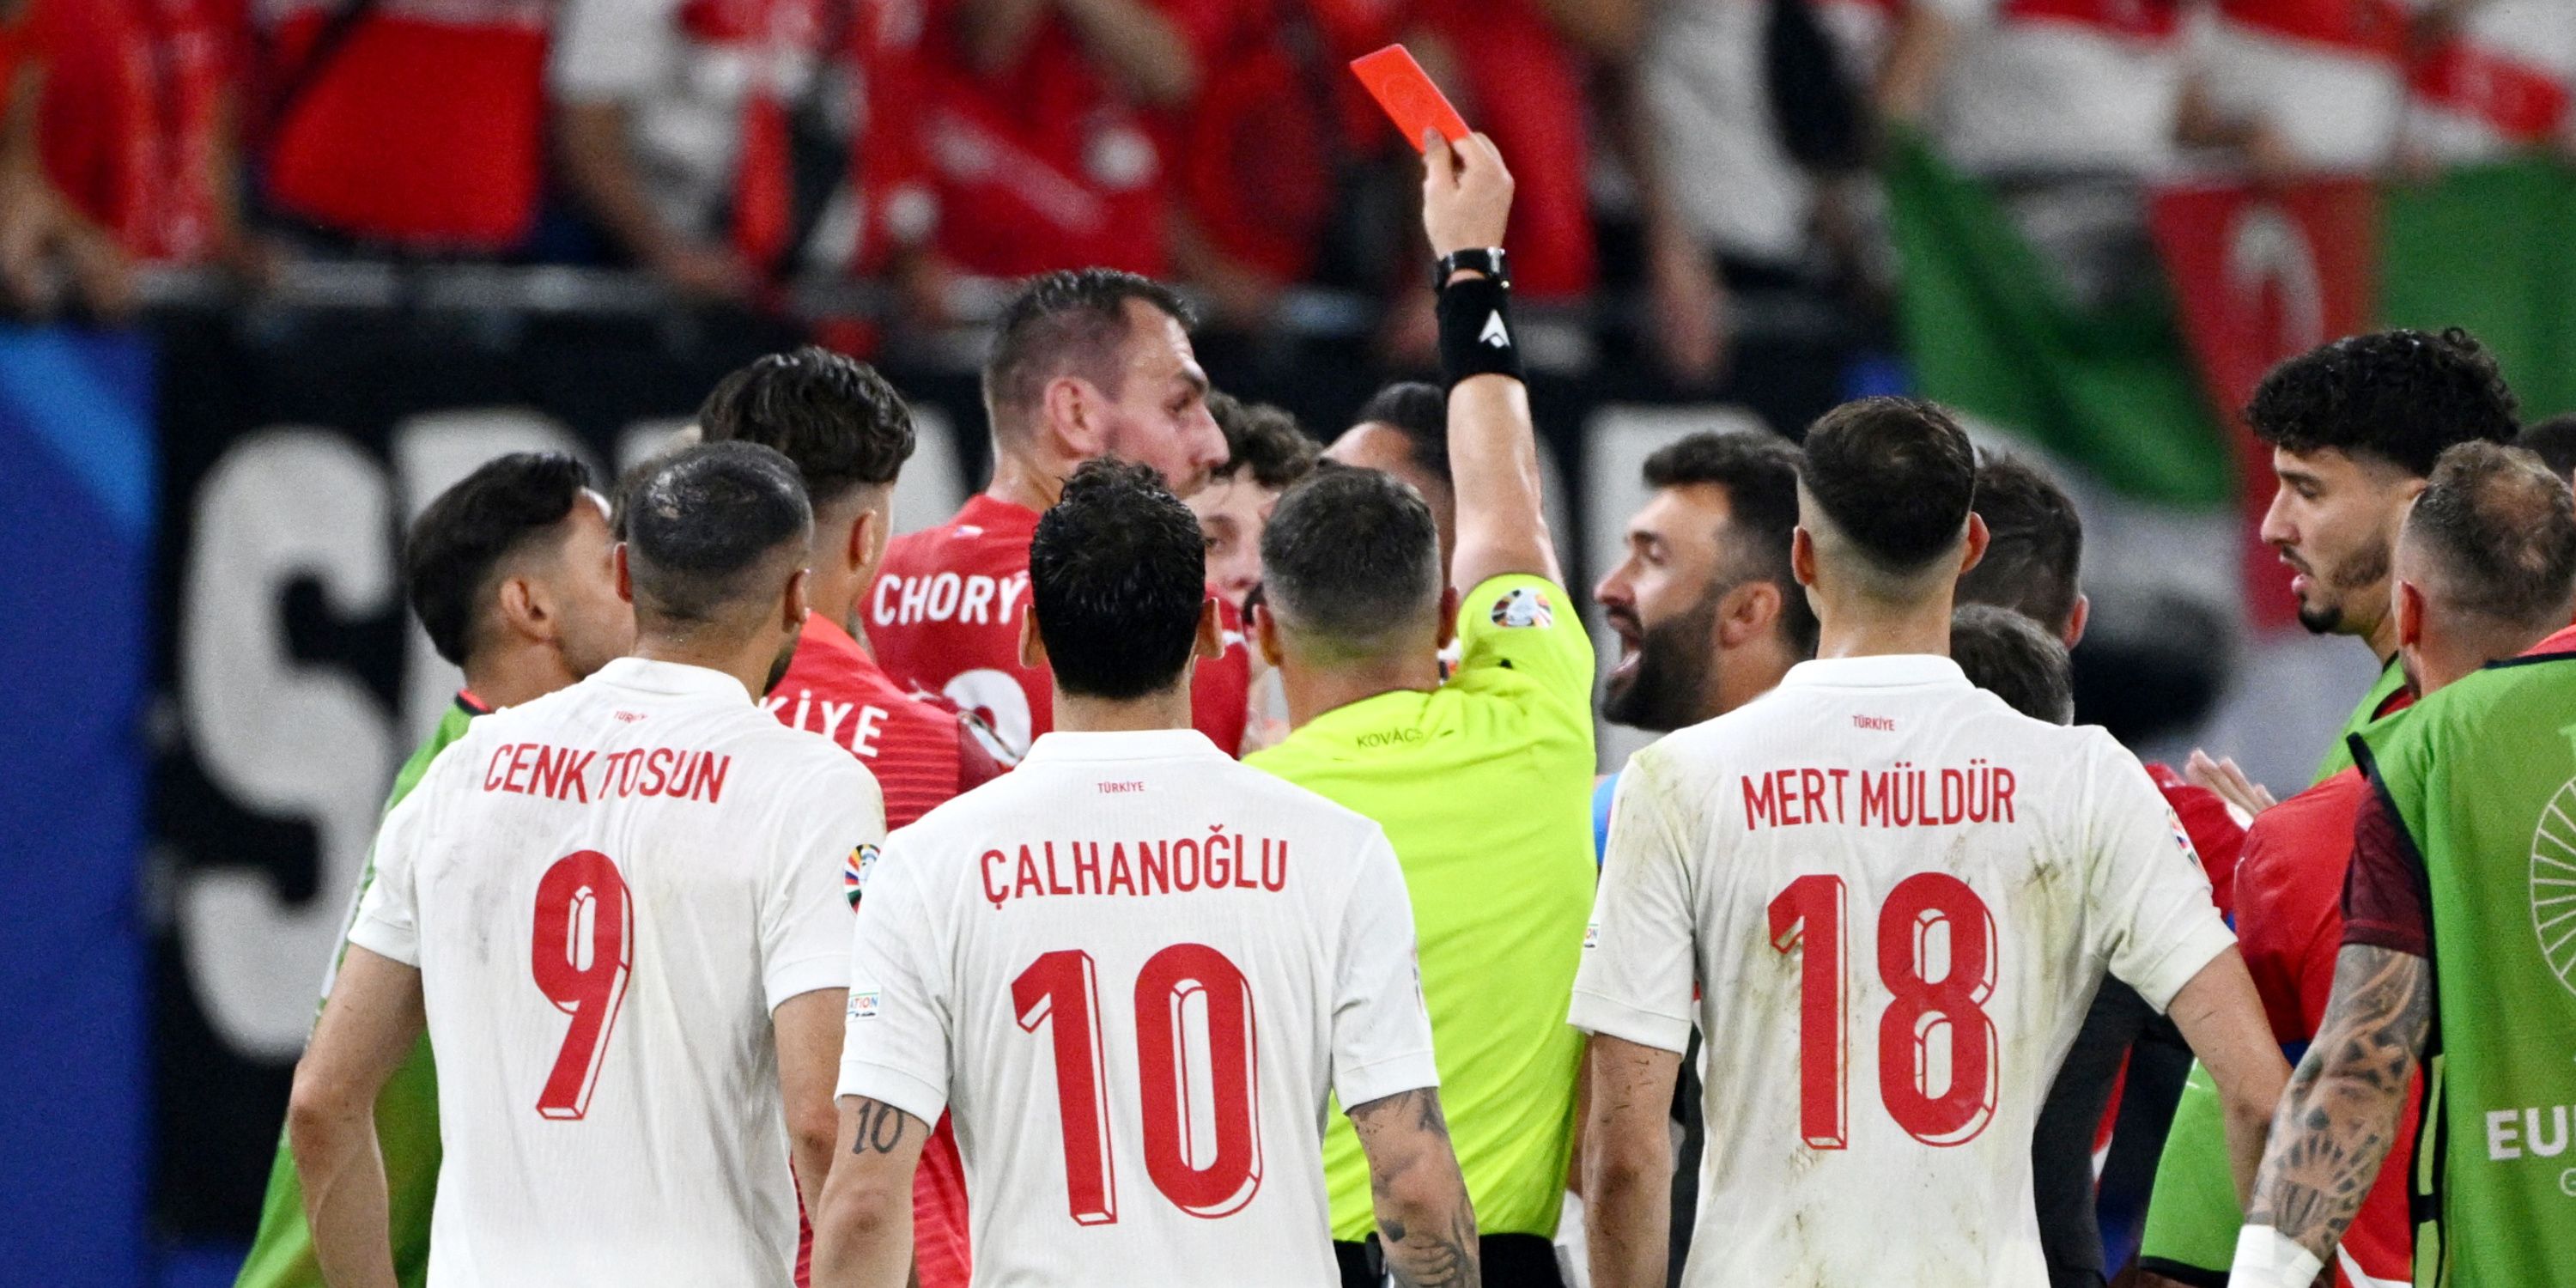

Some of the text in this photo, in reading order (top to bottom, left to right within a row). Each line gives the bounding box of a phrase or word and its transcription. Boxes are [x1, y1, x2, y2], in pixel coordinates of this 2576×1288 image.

[1852, 714, 1895, 732] TÜRKİYE
[484, 744, 731, 804] CENK TOSUN
[1097, 781, 1145, 794] TÜRKİYE
[1741, 759, 2016, 830] MERT MÜLDÜR
[981, 823, 1288, 911] ÇALHANOĞLU
[532, 849, 634, 1121] 9
[1767, 872, 1998, 1151] 18
[1012, 942, 1263, 1227] 10
[853, 1101, 904, 1155] 10
[2487, 1104, 2576, 1160] EU
